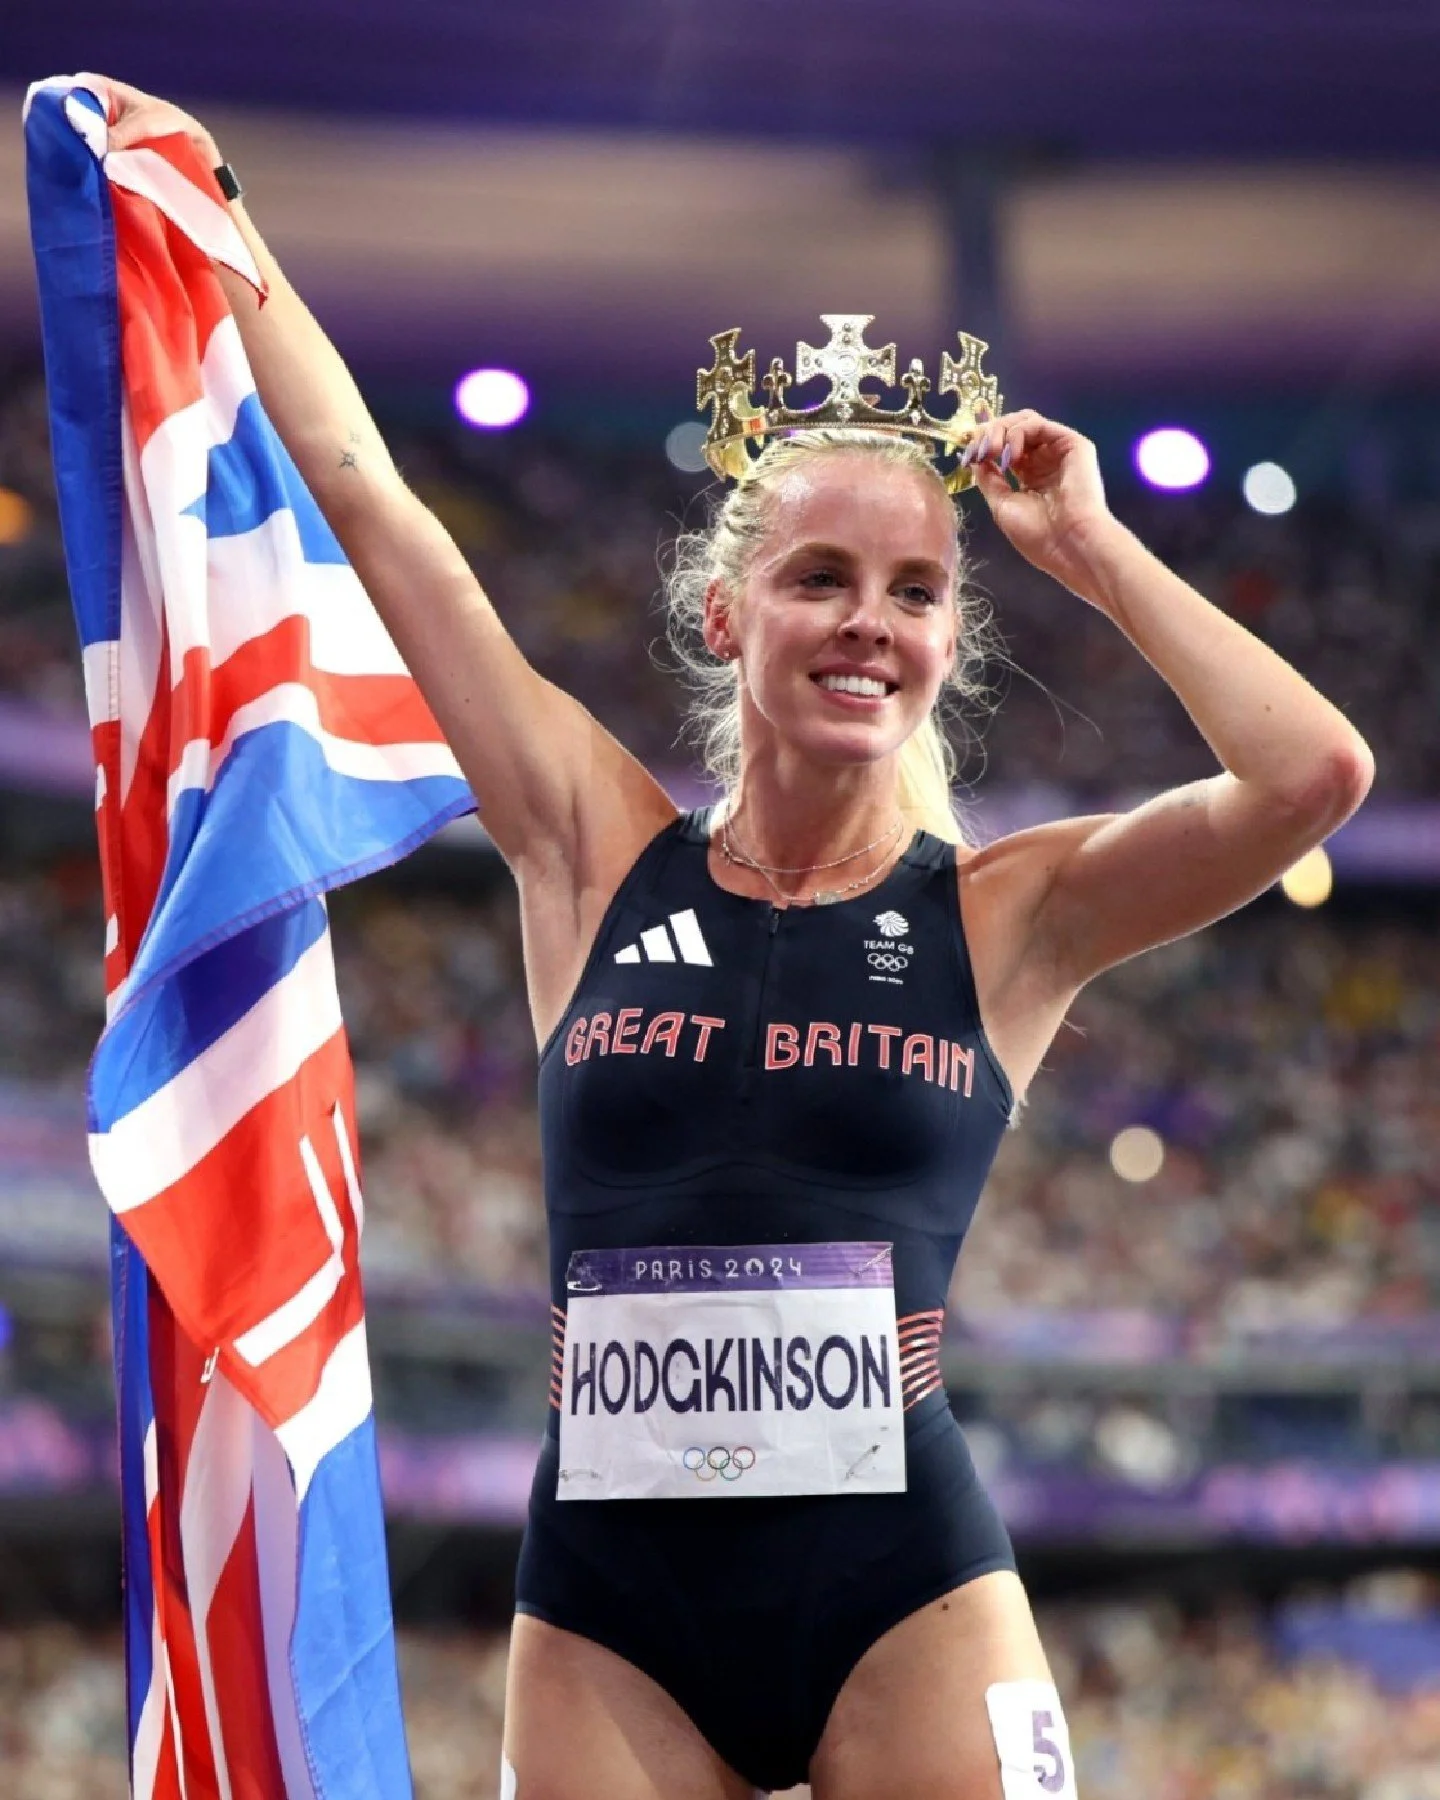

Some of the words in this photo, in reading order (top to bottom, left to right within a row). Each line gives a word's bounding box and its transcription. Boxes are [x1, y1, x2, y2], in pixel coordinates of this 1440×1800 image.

[863, 940, 895, 950] TEAM
[897, 943, 914, 955] GB
[564, 1007, 726, 1066] GREAT
[764, 1021, 975, 1098] BRITAIN
[724, 1257, 802, 1278] 2024
[570, 1334, 891, 1415] HODGKINSON
[1031, 1709, 1065, 1795] 5
